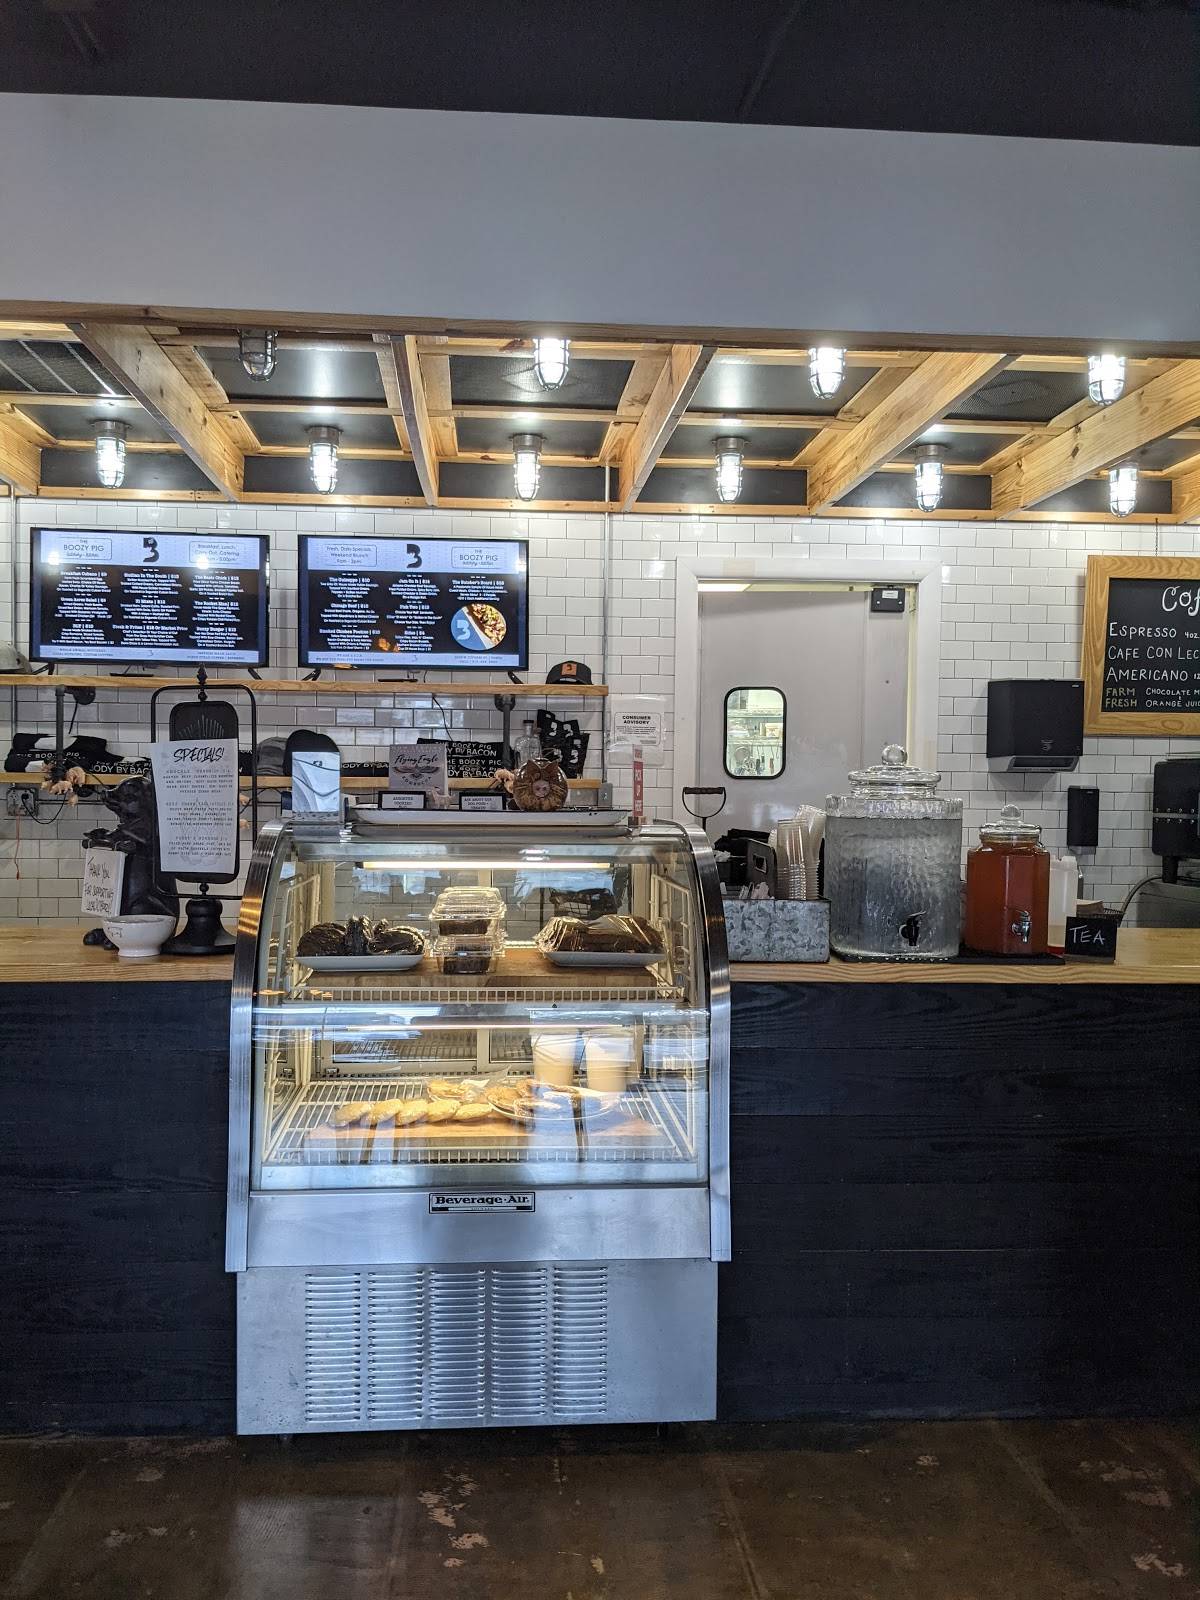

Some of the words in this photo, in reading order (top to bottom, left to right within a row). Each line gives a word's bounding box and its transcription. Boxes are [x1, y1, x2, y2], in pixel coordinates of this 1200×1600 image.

[91, 544, 104, 552] PIG
[1161, 585, 1200, 617] Cof
[1109, 622, 1177, 639] ESPRESSO
[1108, 645, 1140, 661] CAFE
[1147, 646, 1173, 659] CON
[1178, 647, 1200, 660] LEC
[1106, 667, 1188, 682] AMERICANO
[1106, 688, 1136, 697] FARM
[1146, 688, 1191, 696] CHOCOLATE
[1106, 698, 1137, 708] FRESH
[1145, 700, 1182, 708] ORANGE
[173, 747, 225, 763] SPECIALS!
[394, 753, 417, 765] Flying
[418, 753, 439, 764] Eagle
[1069, 924, 1106, 945] TEA
